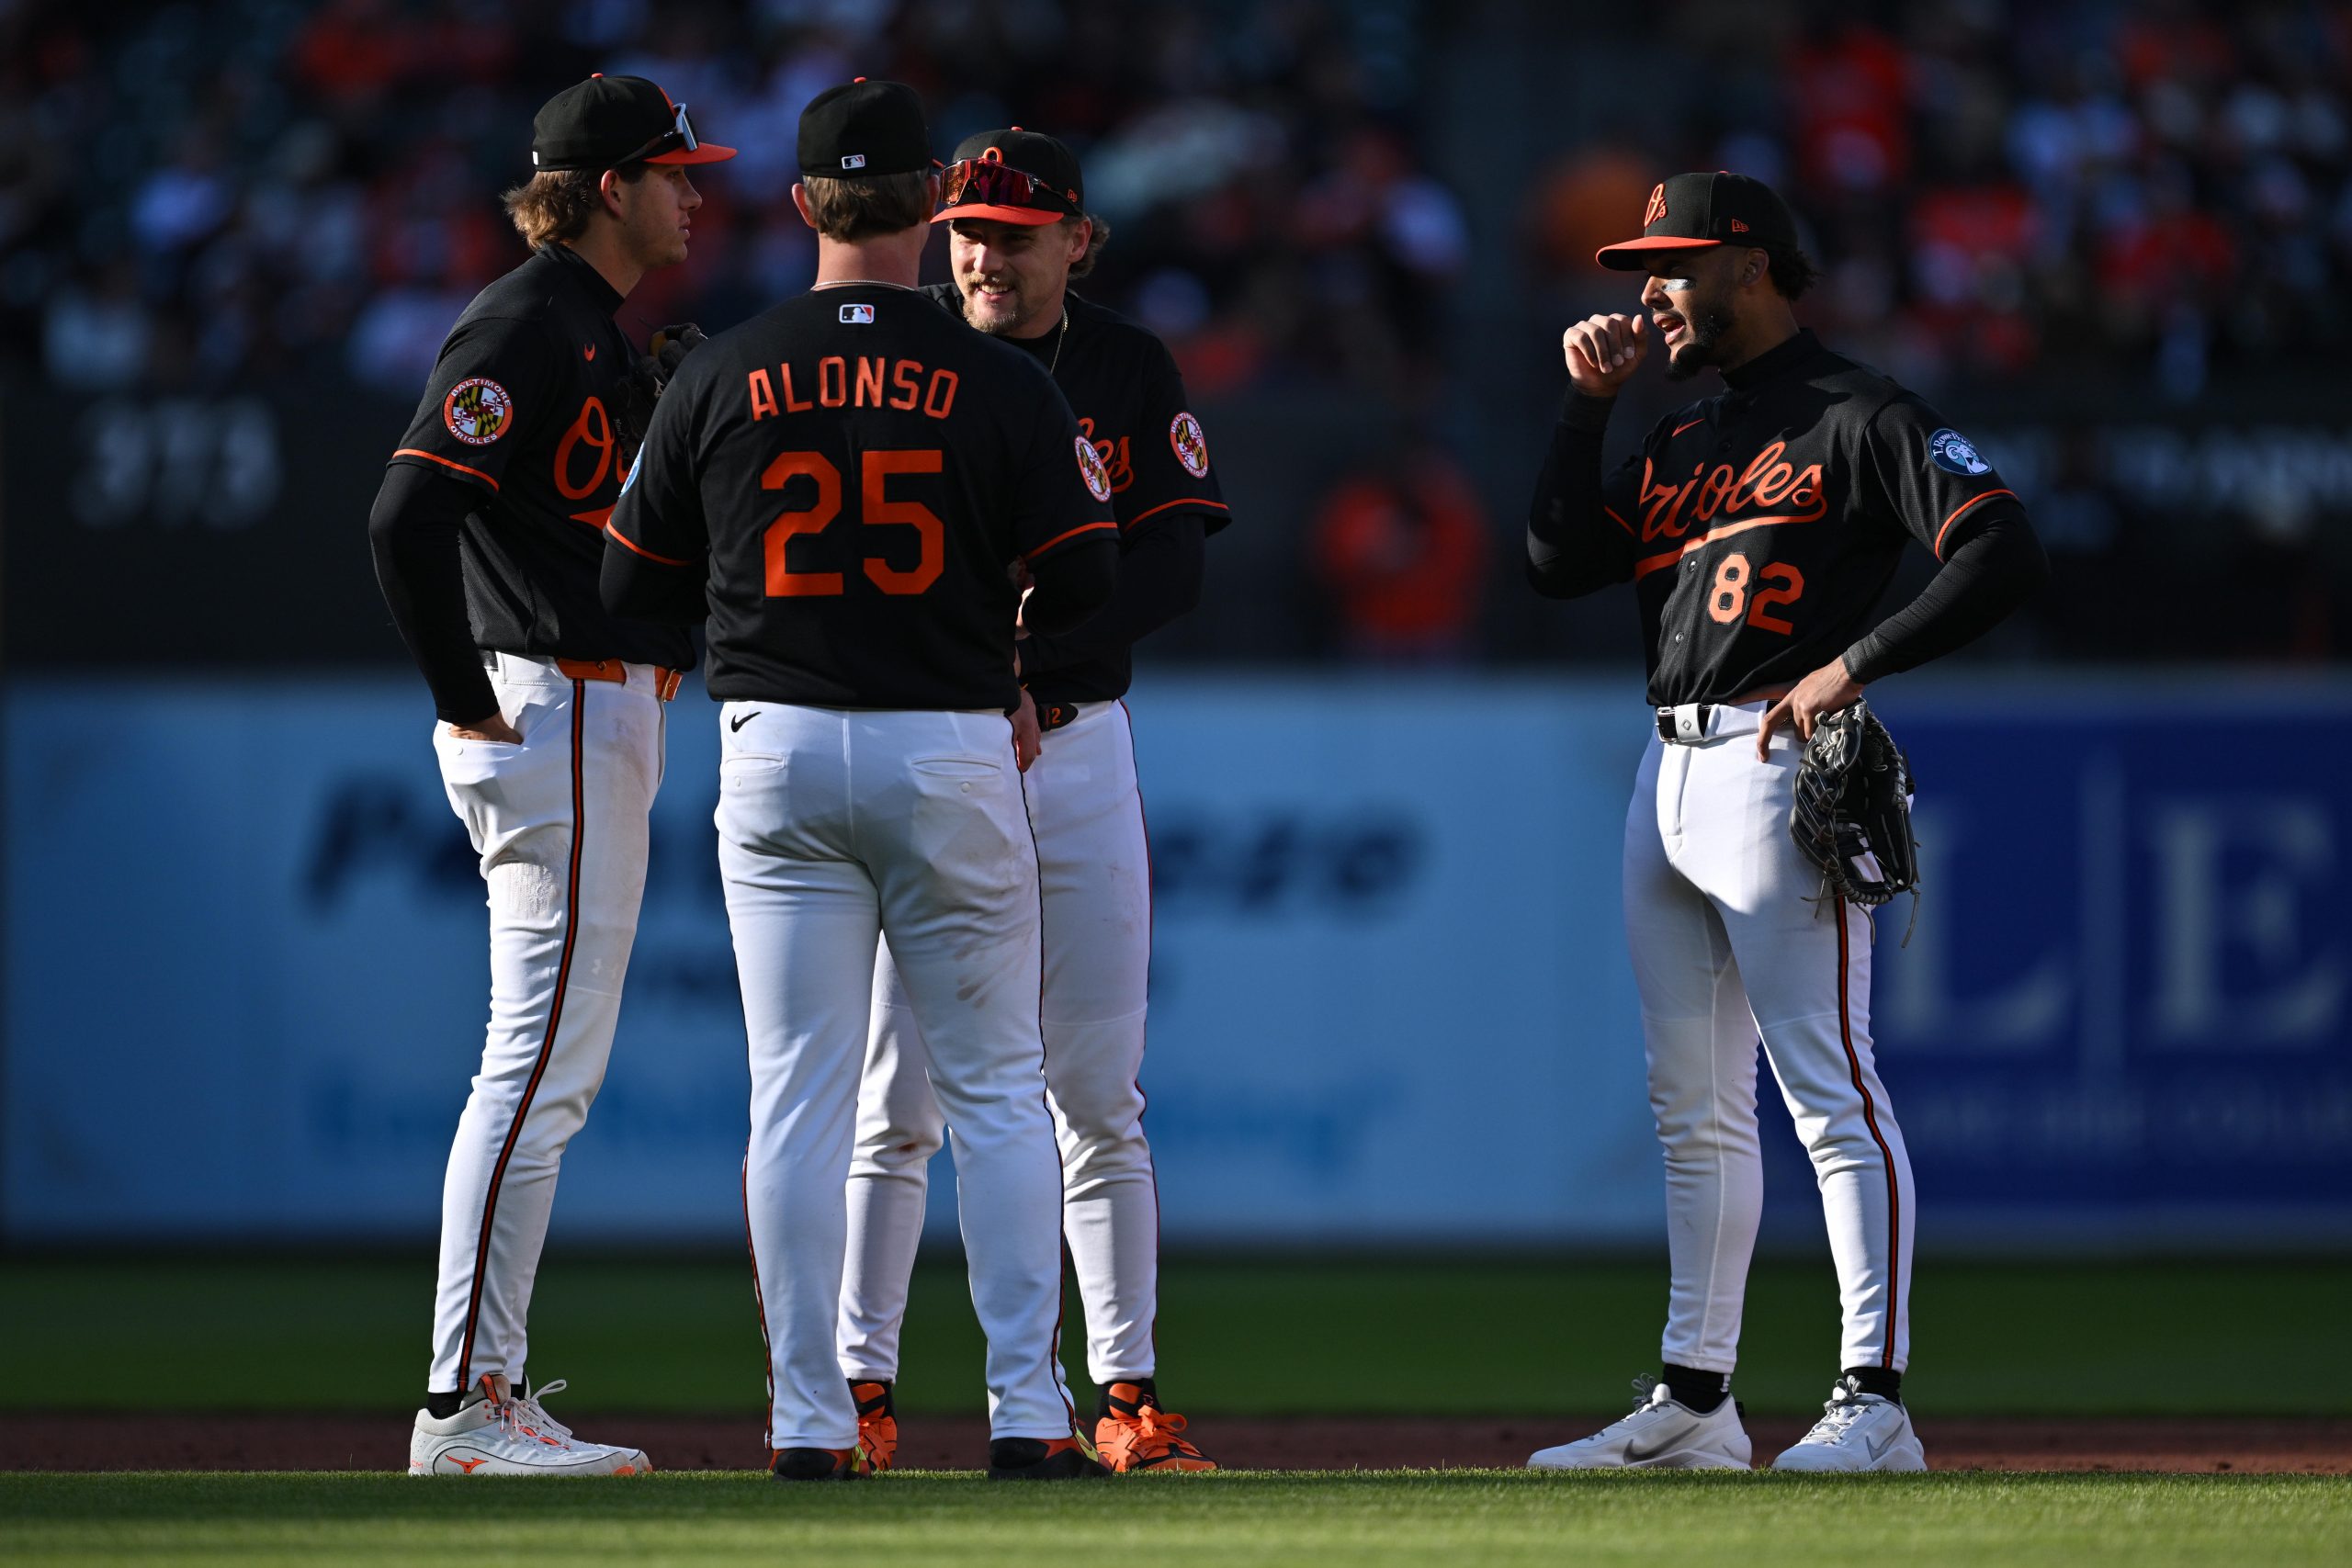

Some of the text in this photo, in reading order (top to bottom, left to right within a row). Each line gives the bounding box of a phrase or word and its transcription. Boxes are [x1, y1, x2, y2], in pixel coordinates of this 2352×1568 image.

[451, 378, 512, 408] BALTIMORE
[749, 355, 959, 422] ALONSO
[450, 425, 498, 445] ORIOLES
[761, 449, 944, 597] 25
[1708, 552, 1805, 636] 82
